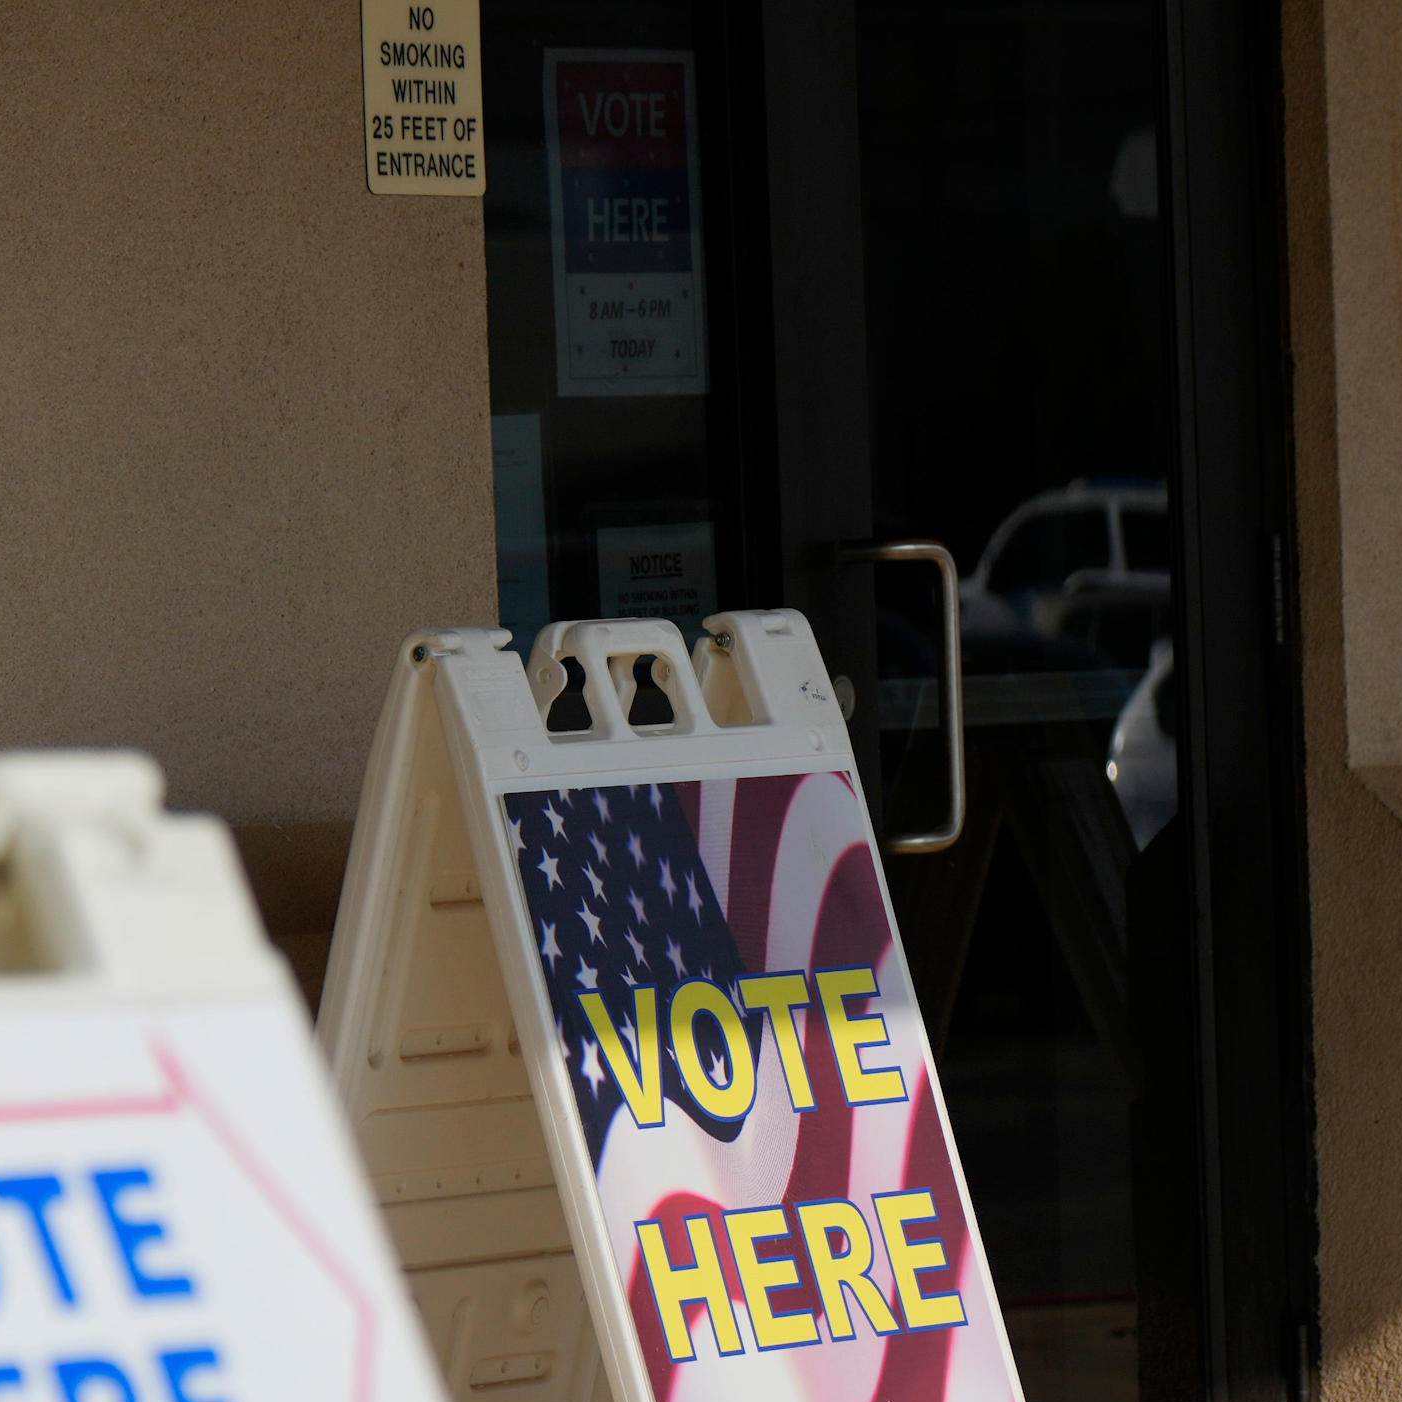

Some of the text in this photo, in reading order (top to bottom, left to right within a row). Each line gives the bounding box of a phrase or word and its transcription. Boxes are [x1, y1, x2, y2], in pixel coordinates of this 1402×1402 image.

[409, 7, 434, 31] NO
[380, 41, 465, 69] SMOKING
[392, 78, 456, 105] WITHIN
[578, 92, 668, 137] VOTE
[373, 115, 476, 142] 25 FEET OF
[377, 152, 476, 178] ENTRANCE
[588, 197, 670, 243] HERE
[601, 300, 623, 320] AM
[649, 298, 671, 317] PM
[610, 338, 655, 359] TODAY
[630, 553, 682, 575] NOTICE
[574, 963, 909, 1130] VOTE
[634, 1187, 968, 1365] HERE
